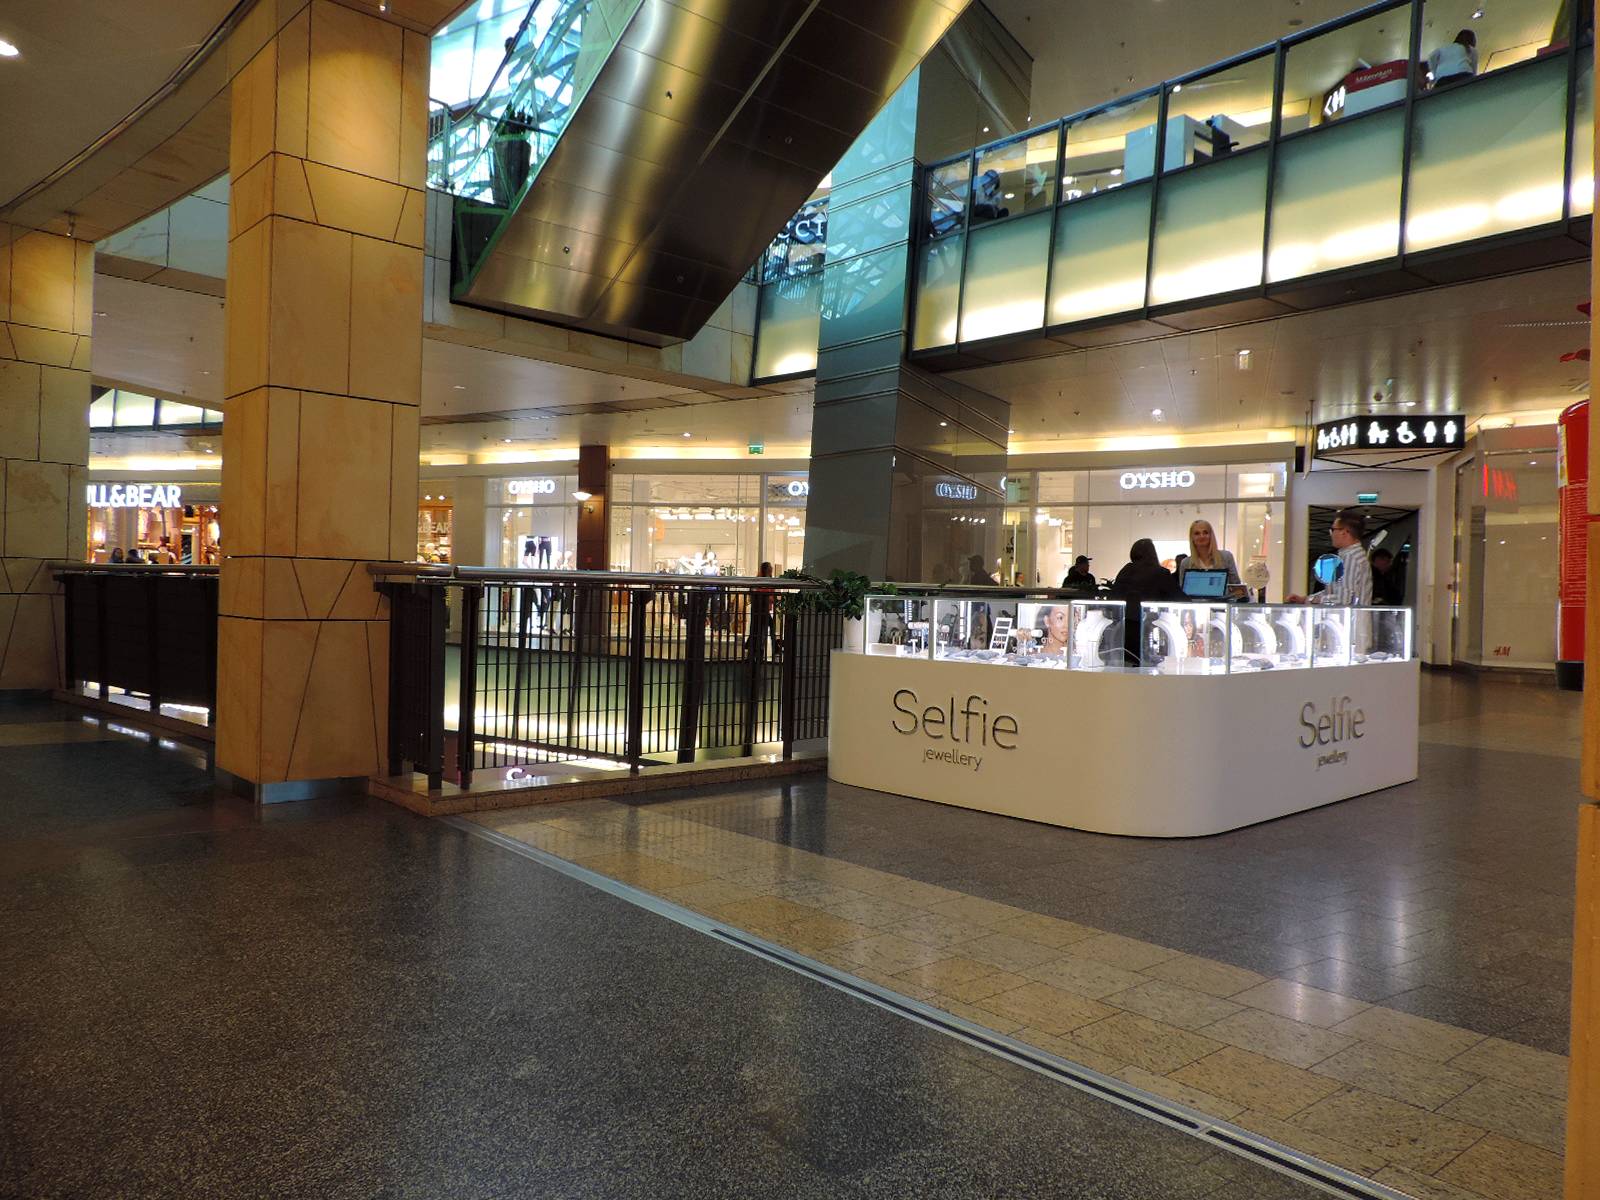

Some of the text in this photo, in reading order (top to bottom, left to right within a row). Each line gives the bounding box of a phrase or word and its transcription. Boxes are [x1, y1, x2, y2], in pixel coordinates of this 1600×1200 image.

[508, 480, 555, 494] OYSHO
[1119, 470, 1195, 490] OYSHO
[892, 689, 1019, 750] Selfie
[1299, 695, 1366, 749] Selfie
[922, 748, 982, 772] jewellery
